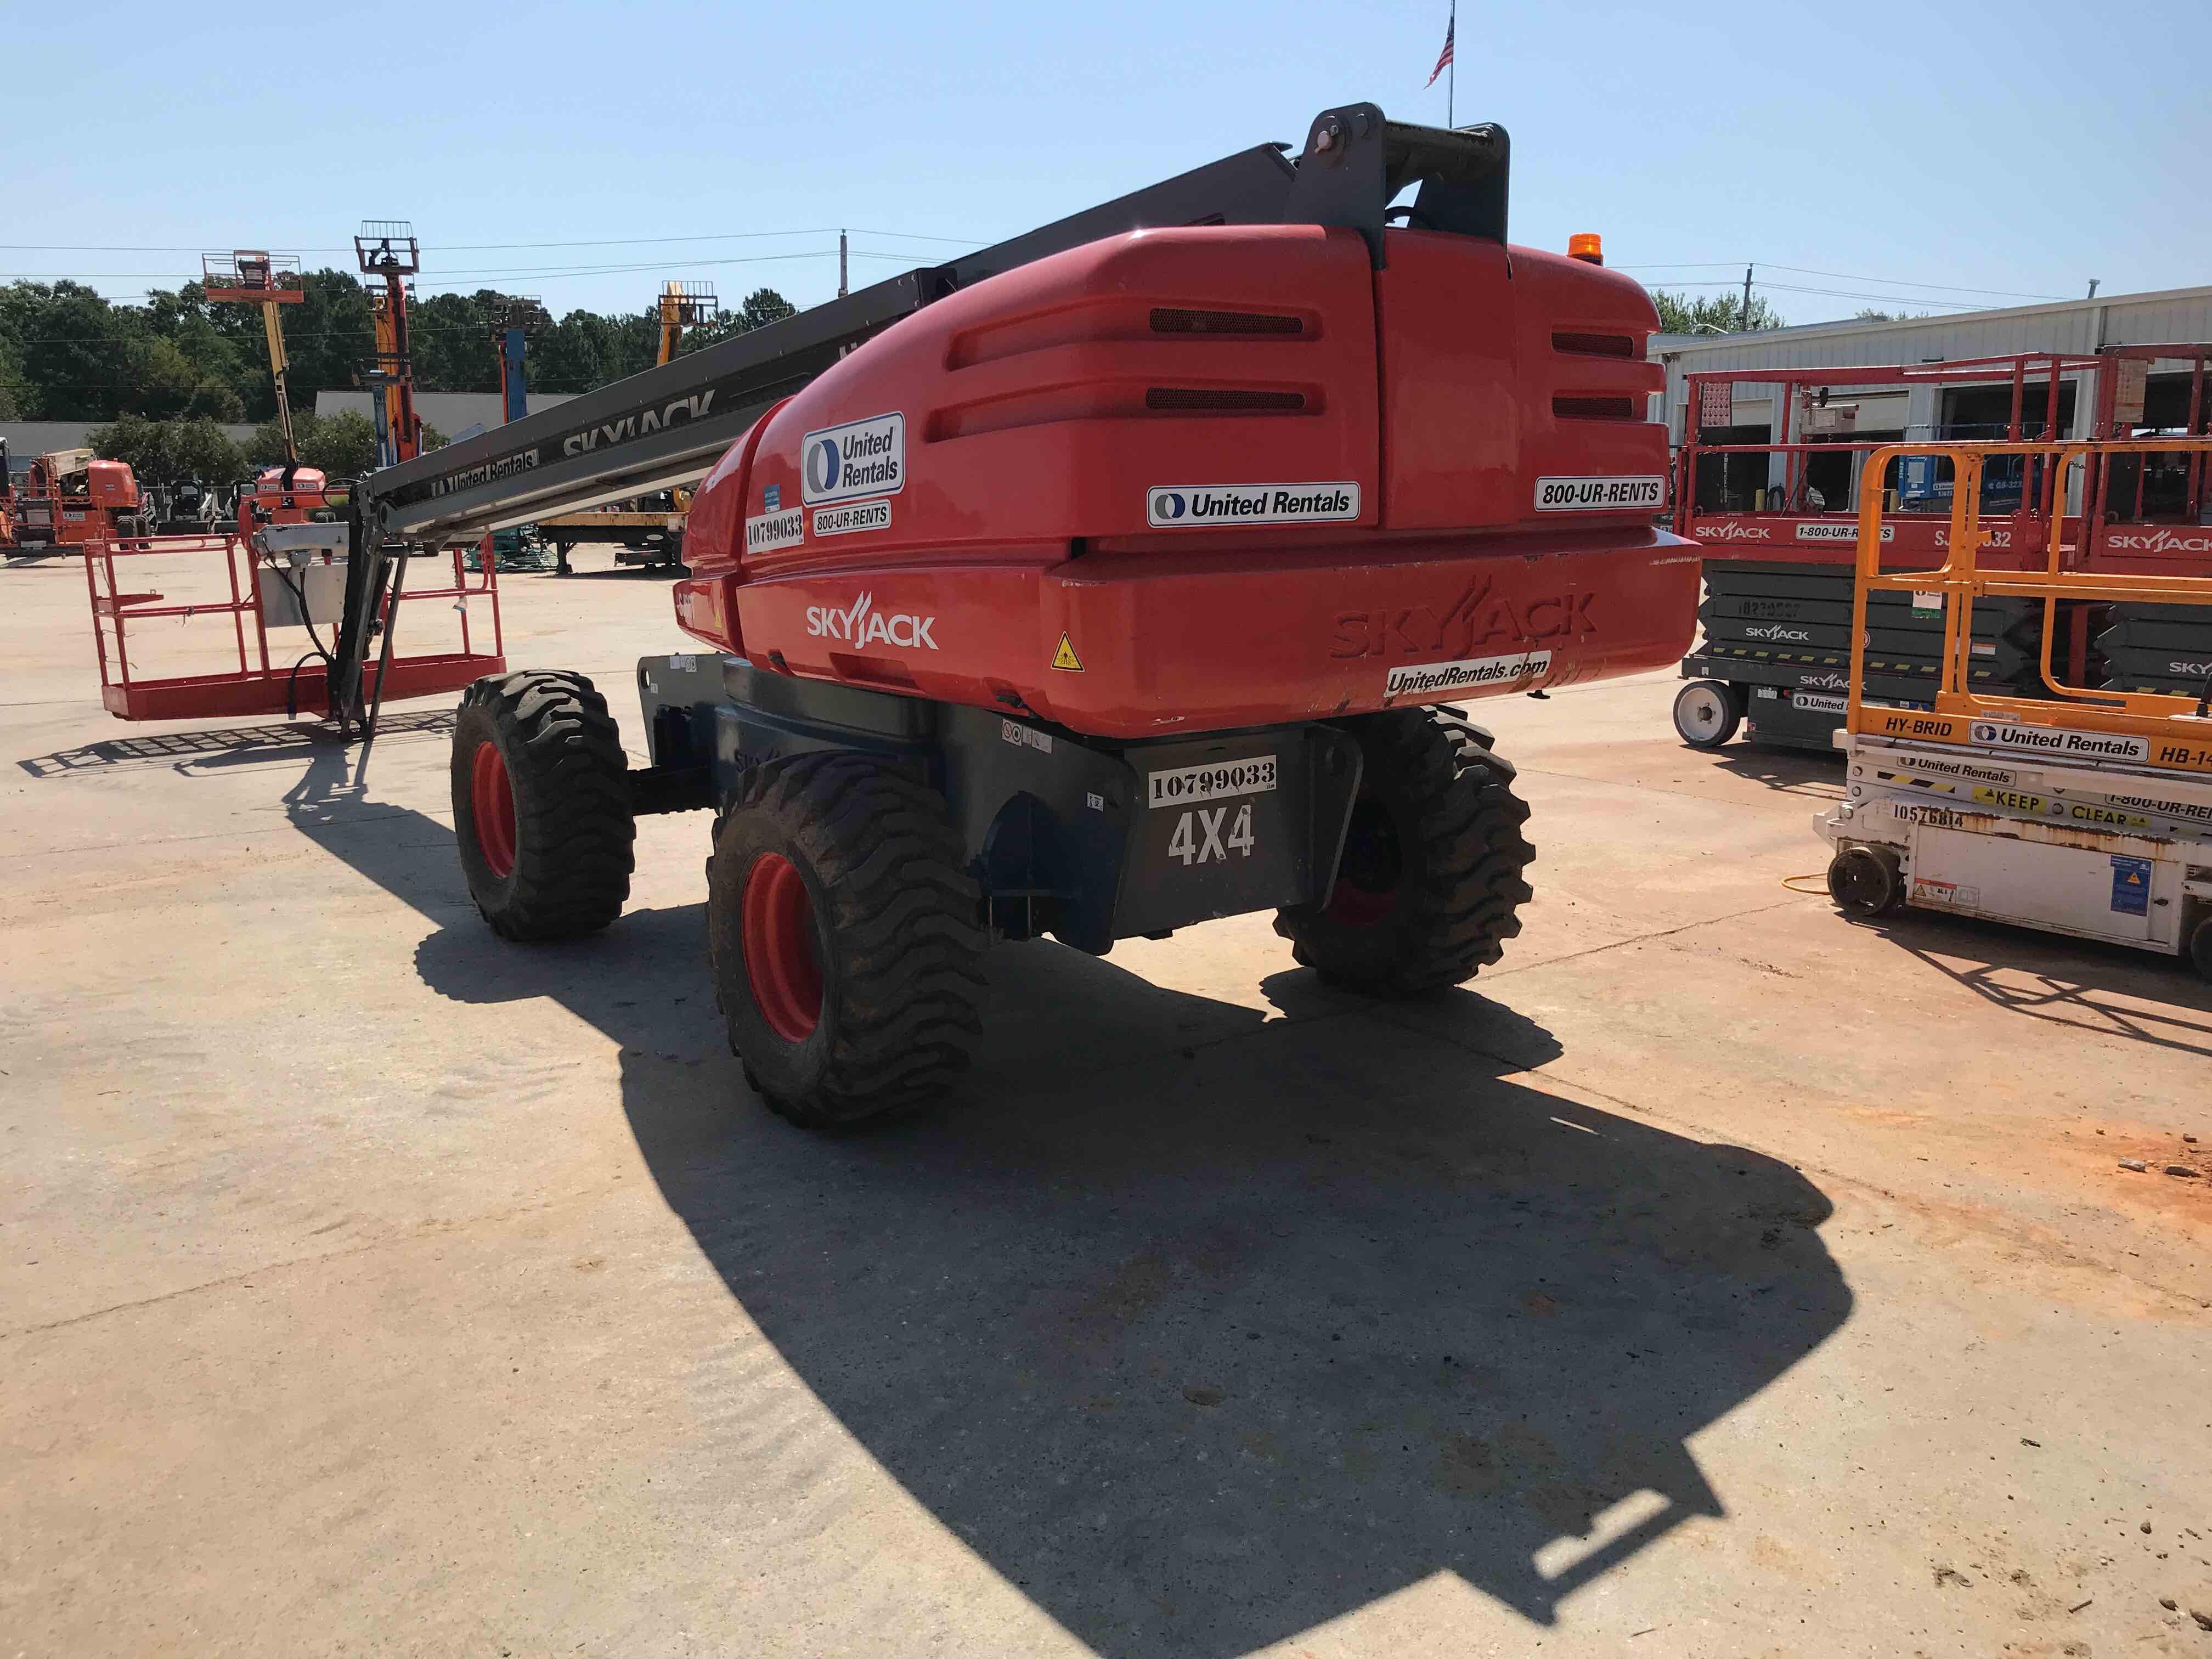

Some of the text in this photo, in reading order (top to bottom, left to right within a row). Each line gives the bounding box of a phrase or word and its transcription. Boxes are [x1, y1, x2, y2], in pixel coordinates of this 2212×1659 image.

[843, 426, 894, 460] United
[843, 456, 898, 488] Rentals
[1192, 490, 1350, 517] United Rentals
[1542, 481, 1659, 504] 800-UR-RENTS
[747, 514, 803, 546] 10799033
[816, 506, 888, 531] 800-UR-RENTS
[1695, 521, 1771, 540] SKYJACK
[806, 591, 940, 650] SKYJACK
[1329, 572, 1598, 661] SKYJACK
[1745, 624, 1810, 641] SKYJACK
[1389, 658, 1548, 692] UnitedRentals.com
[2169, 660, 2212, 676] SKY
[1811, 698, 1844, 710] United
[1885, 717, 1953, 737] HY-BRID
[2001, 728, 2140, 757] United Rentals
[1153, 762, 1276, 799] 10799033
[1918, 759, 2011, 783] United Rentals
[1996, 792, 2128, 826] KEEP CLEAR
[2110, 794, 2212, 819] 1-800-UR-RE
[1168, 804, 1255, 866] 4X4
